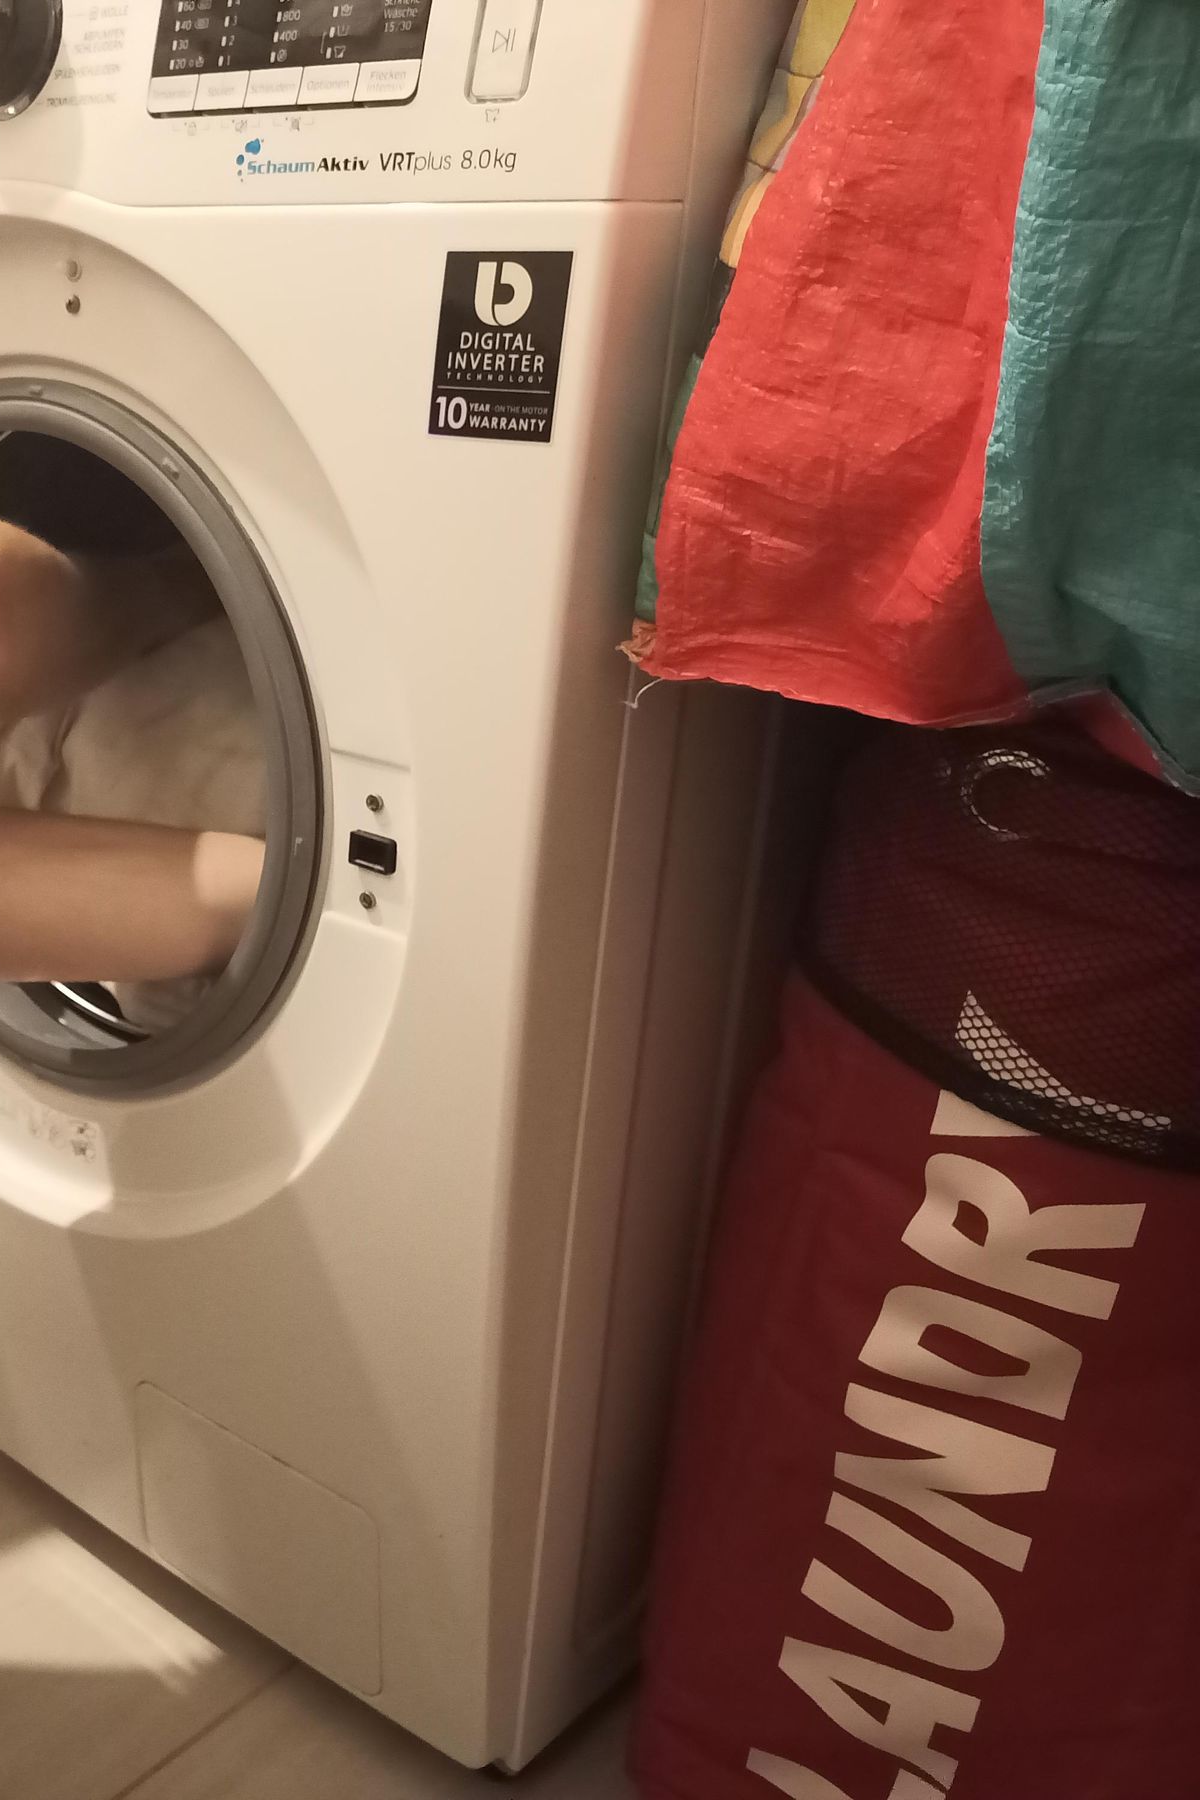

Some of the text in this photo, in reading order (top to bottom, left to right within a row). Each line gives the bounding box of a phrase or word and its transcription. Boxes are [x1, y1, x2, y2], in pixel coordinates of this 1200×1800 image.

[181, 20, 192, 30] 40
[282, 10, 301, 22] 800
[279, 30, 299, 42] 400
[379, 151, 452, 175] VRTplus
[459, 331, 535, 351] DIGITAL
[447, 352, 545, 373] INVERTER
[446, 372, 544, 384] TECHNOLOGY
[435, 396, 468, 430] 10
[469, 402, 491, 413] YEAR
[521, 405, 549, 416] MOTOR
[469, 415, 546, 433] WARRANTY
